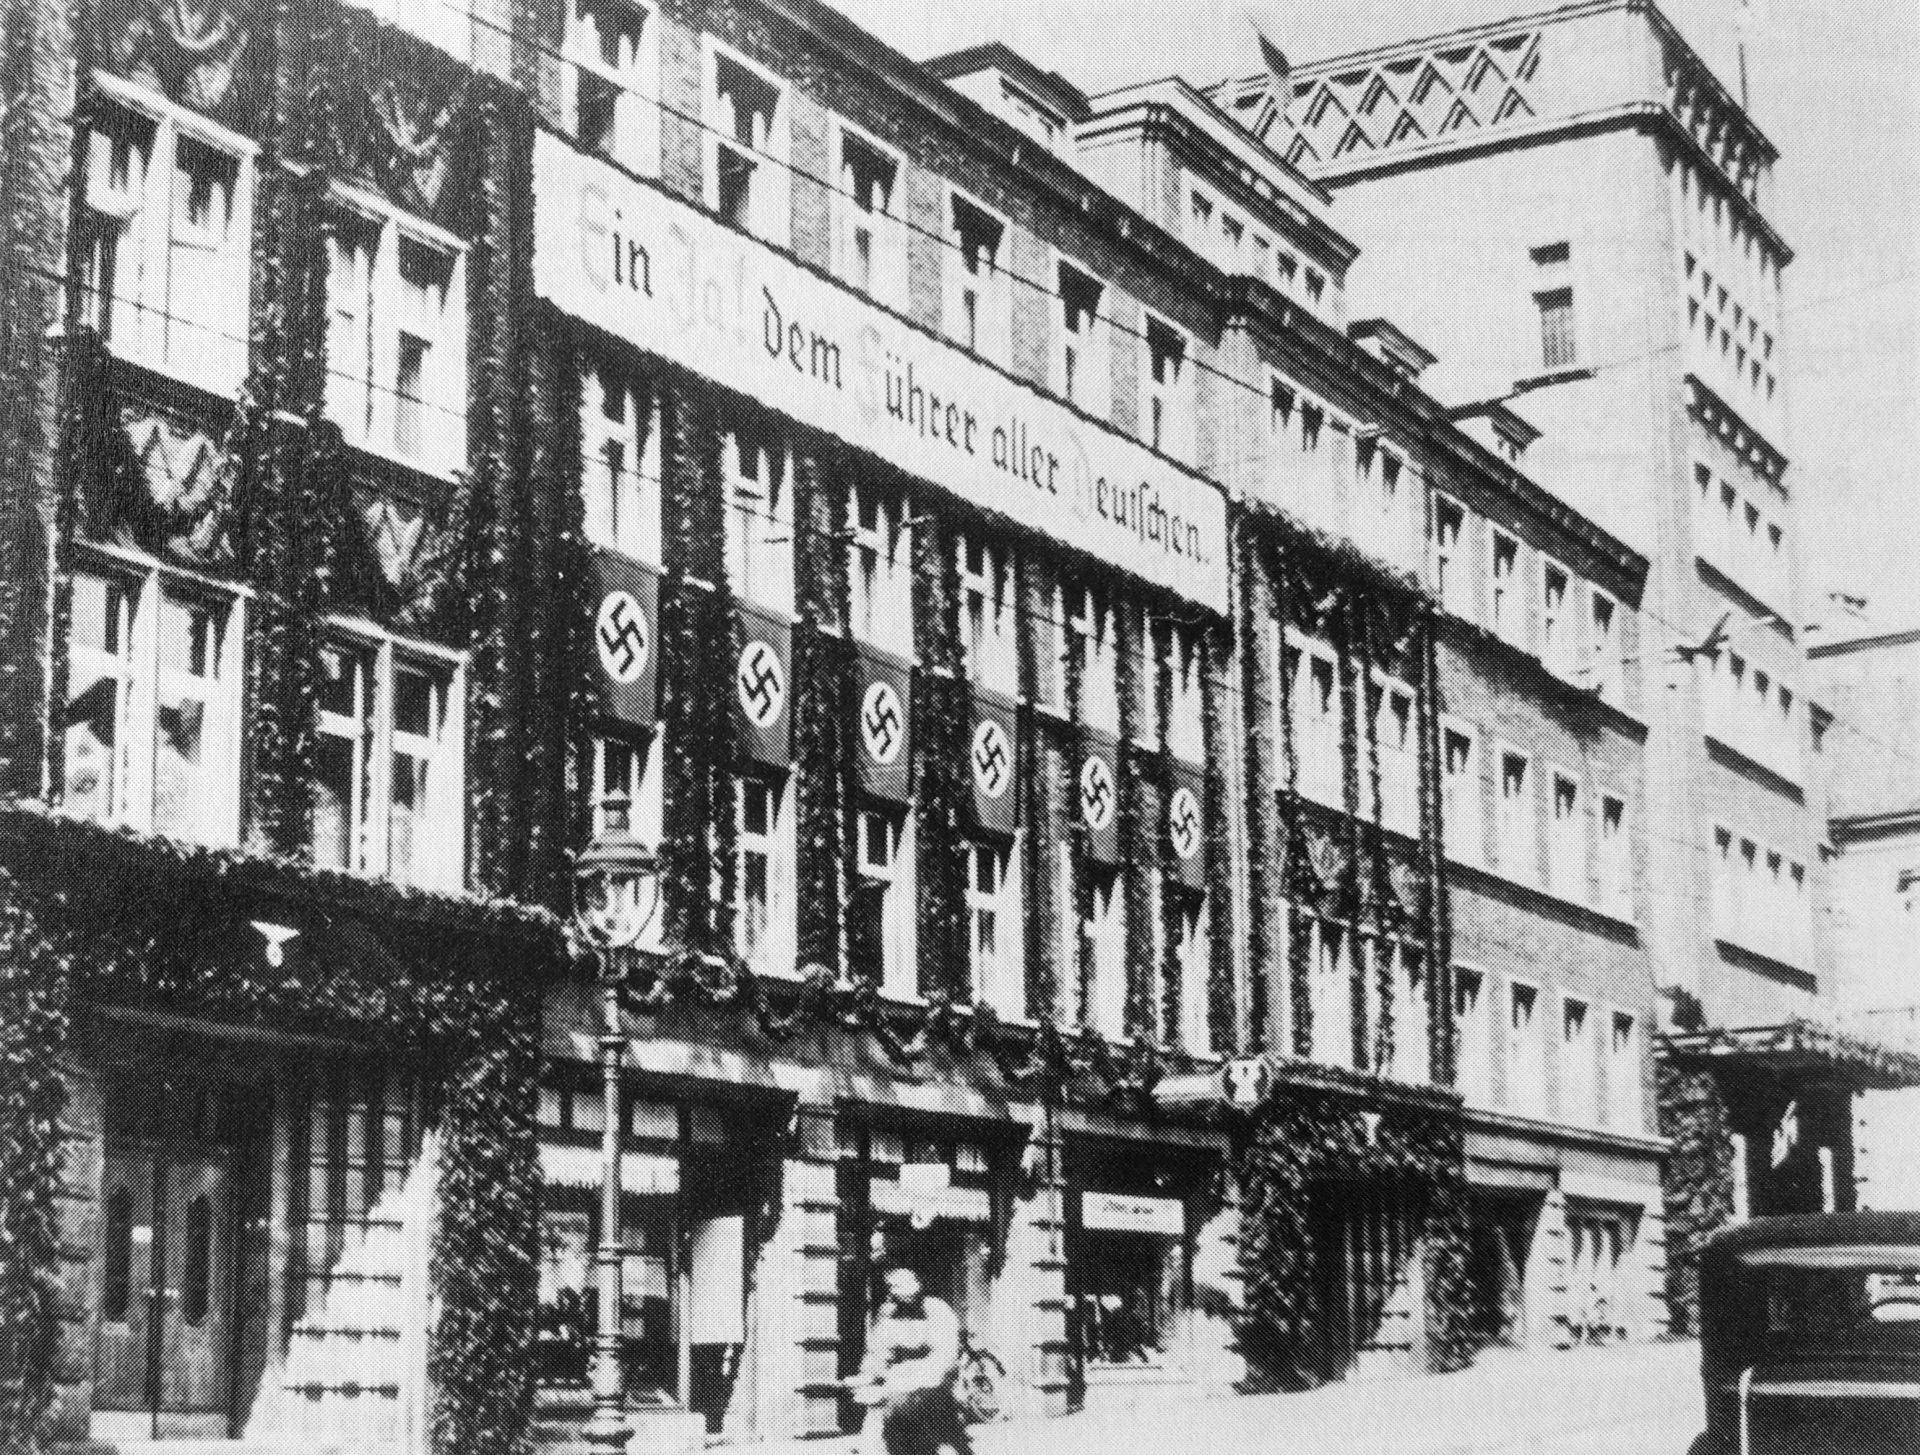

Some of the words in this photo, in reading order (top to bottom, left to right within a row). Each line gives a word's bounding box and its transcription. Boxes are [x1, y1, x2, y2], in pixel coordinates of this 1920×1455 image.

[577, 182, 653, 299] Ein
[762, 284, 843, 389] dem
[855, 323, 978, 456] Führer
[991, 416, 1060, 496] aller
